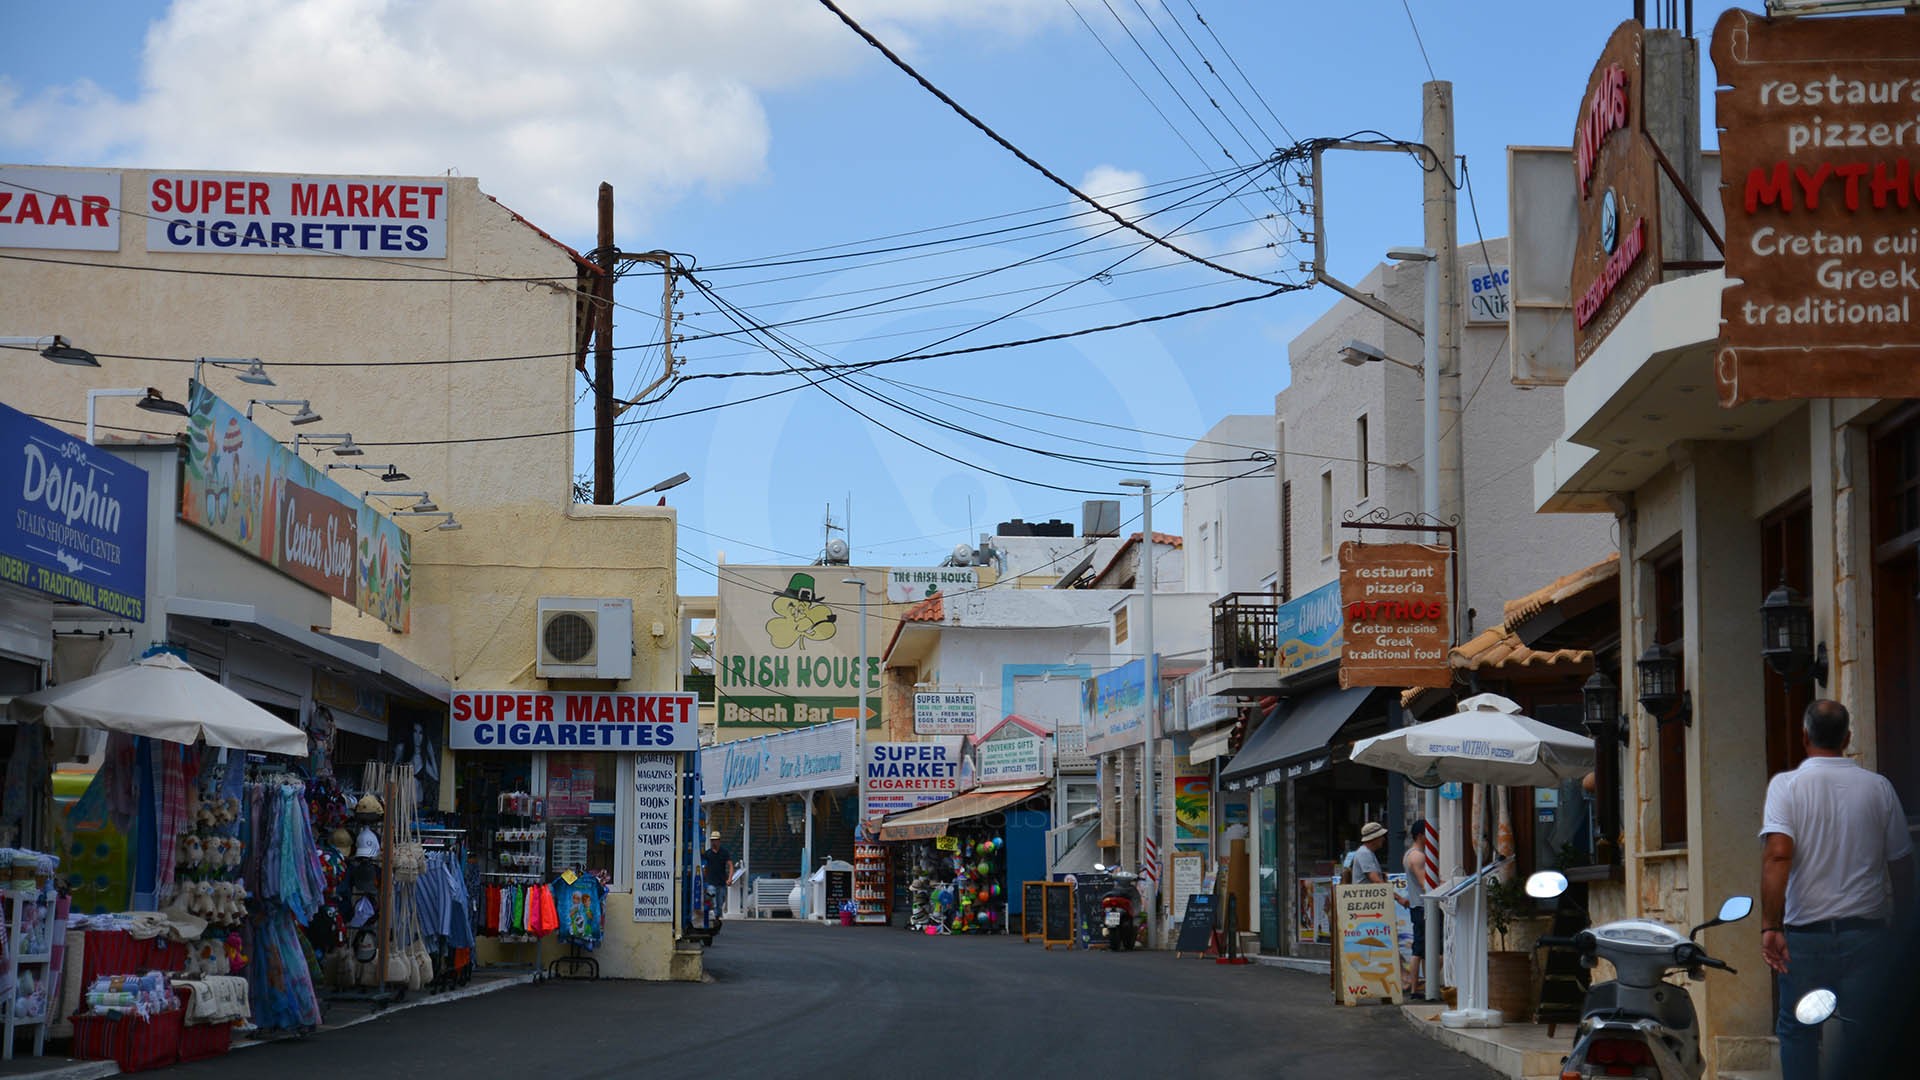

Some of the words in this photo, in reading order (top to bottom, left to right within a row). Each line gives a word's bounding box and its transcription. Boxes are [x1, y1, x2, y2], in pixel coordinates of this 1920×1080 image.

[1578, 62, 1628, 201] MYTHOS
[1745, 158, 1920, 215] MYTH
[152, 178, 270, 216] SUPER
[291, 183, 443, 220] MARKET
[166, 219, 429, 252] CIGARETTES
[1751, 226, 1863, 257] Cretan
[1816, 259, 1920, 290] Greek
[1742, 296, 1910, 325] traditional
[23, 443, 121, 535] Dolphin
[16, 508, 47, 539] STALIS
[46, 518, 90, 554] SHOPPING
[90, 538, 121, 565] CENTER
[284, 506, 323, 570] Center
[323, 513, 353, 596] Shop
[894, 572, 910, 582] THE
[914, 572, 937, 582] IRISH
[941, 572, 972, 583] HOUSE
[1356, 566, 1434, 578] restaurant
[38, 569, 96, 607] TRADITIONAL
[98, 588, 142, 620] PRODUCTS
[1366, 582, 1424, 596] pizzeria
[1350, 601, 1441, 620] MYTHOS
[1352, 623, 1393, 634] Cretan
[1397, 624, 1438, 634] cuisine
[1376, 635, 1414, 647] Greek
[1349, 648, 1410, 660] traditional
[1414, 648, 1441, 660] food
[722, 655, 790, 688] IRISH
[796, 655, 881, 689] HOUSE
[917, 695, 940, 704] SUPER
[945, 695, 974, 704] MARKET
[453, 694, 554, 722] SUPER
[566, 695, 693, 723] MARKET
[723, 702, 789, 723] Beach
[793, 703, 830, 723] Bar
[474, 724, 675, 746] CIGARETTES
[986, 742, 1015, 753] SOUVENIRS
[1016, 740, 1034, 749] GIFTS
[1429, 744, 1460, 753] RESTAURANT
[1462, 740, 1490, 756] MYTHOS
[1491, 747, 1514, 758] PIZZERIA
[874, 746, 946, 761] SUPER
[636, 754, 675, 766] CIGARETTES
[780, 757, 794, 778] Bar
[802, 752, 842, 777] Restaurant
[637, 769, 673, 780] MAGAZINES
[867, 763, 958, 778] MARKET
[1002, 765, 1022, 774] ARTICLES
[635, 783, 675, 793] NEWSPAPERS
[868, 779, 956, 789] CIGARETTES
[640, 797, 670, 809] BOOKS
[640, 812, 669, 821] PHONE
[640, 822, 668, 830] CARDS
[637, 834, 671, 845] STAMPS
[643, 850, 663, 858] POST
[640, 859, 666, 867] CARDS
[636, 871, 671, 881] BIRTHDAY
[641, 883, 665, 892] CARDS
[1343, 888, 1387, 899] MYTHOS
[638, 896, 669, 906] MOSQUITO
[1347, 900, 1385, 911] BEACH
[634, 907, 672, 918] PROTECTION
[1344, 929, 1361, 937] free
[1366, 926, 1391, 936] wi-fi
[1349, 985, 1368, 995] WC
